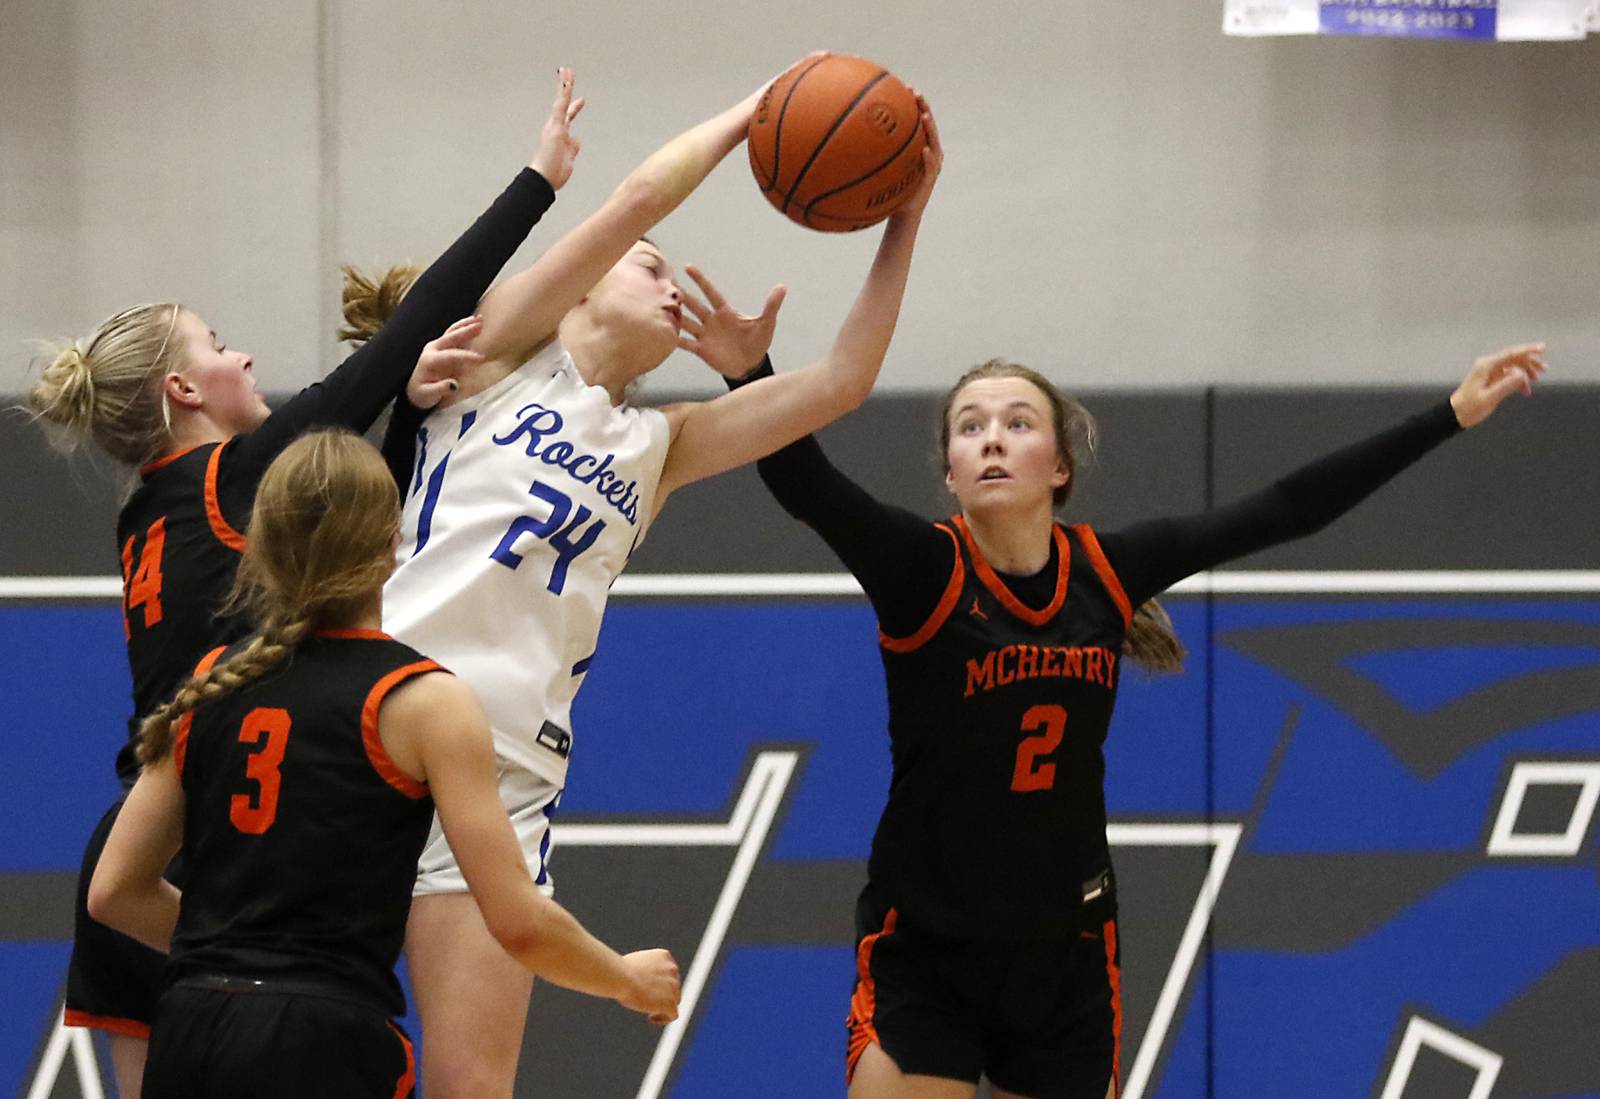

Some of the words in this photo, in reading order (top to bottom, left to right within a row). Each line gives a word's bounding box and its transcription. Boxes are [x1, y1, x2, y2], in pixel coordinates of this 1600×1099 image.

[492, 403, 641, 527] Rockets
[489, 480, 607, 596] 24
[964, 644, 1117, 697] MCHENRY
[229, 707, 292, 835] 3
[1011, 704, 1068, 792] 2
